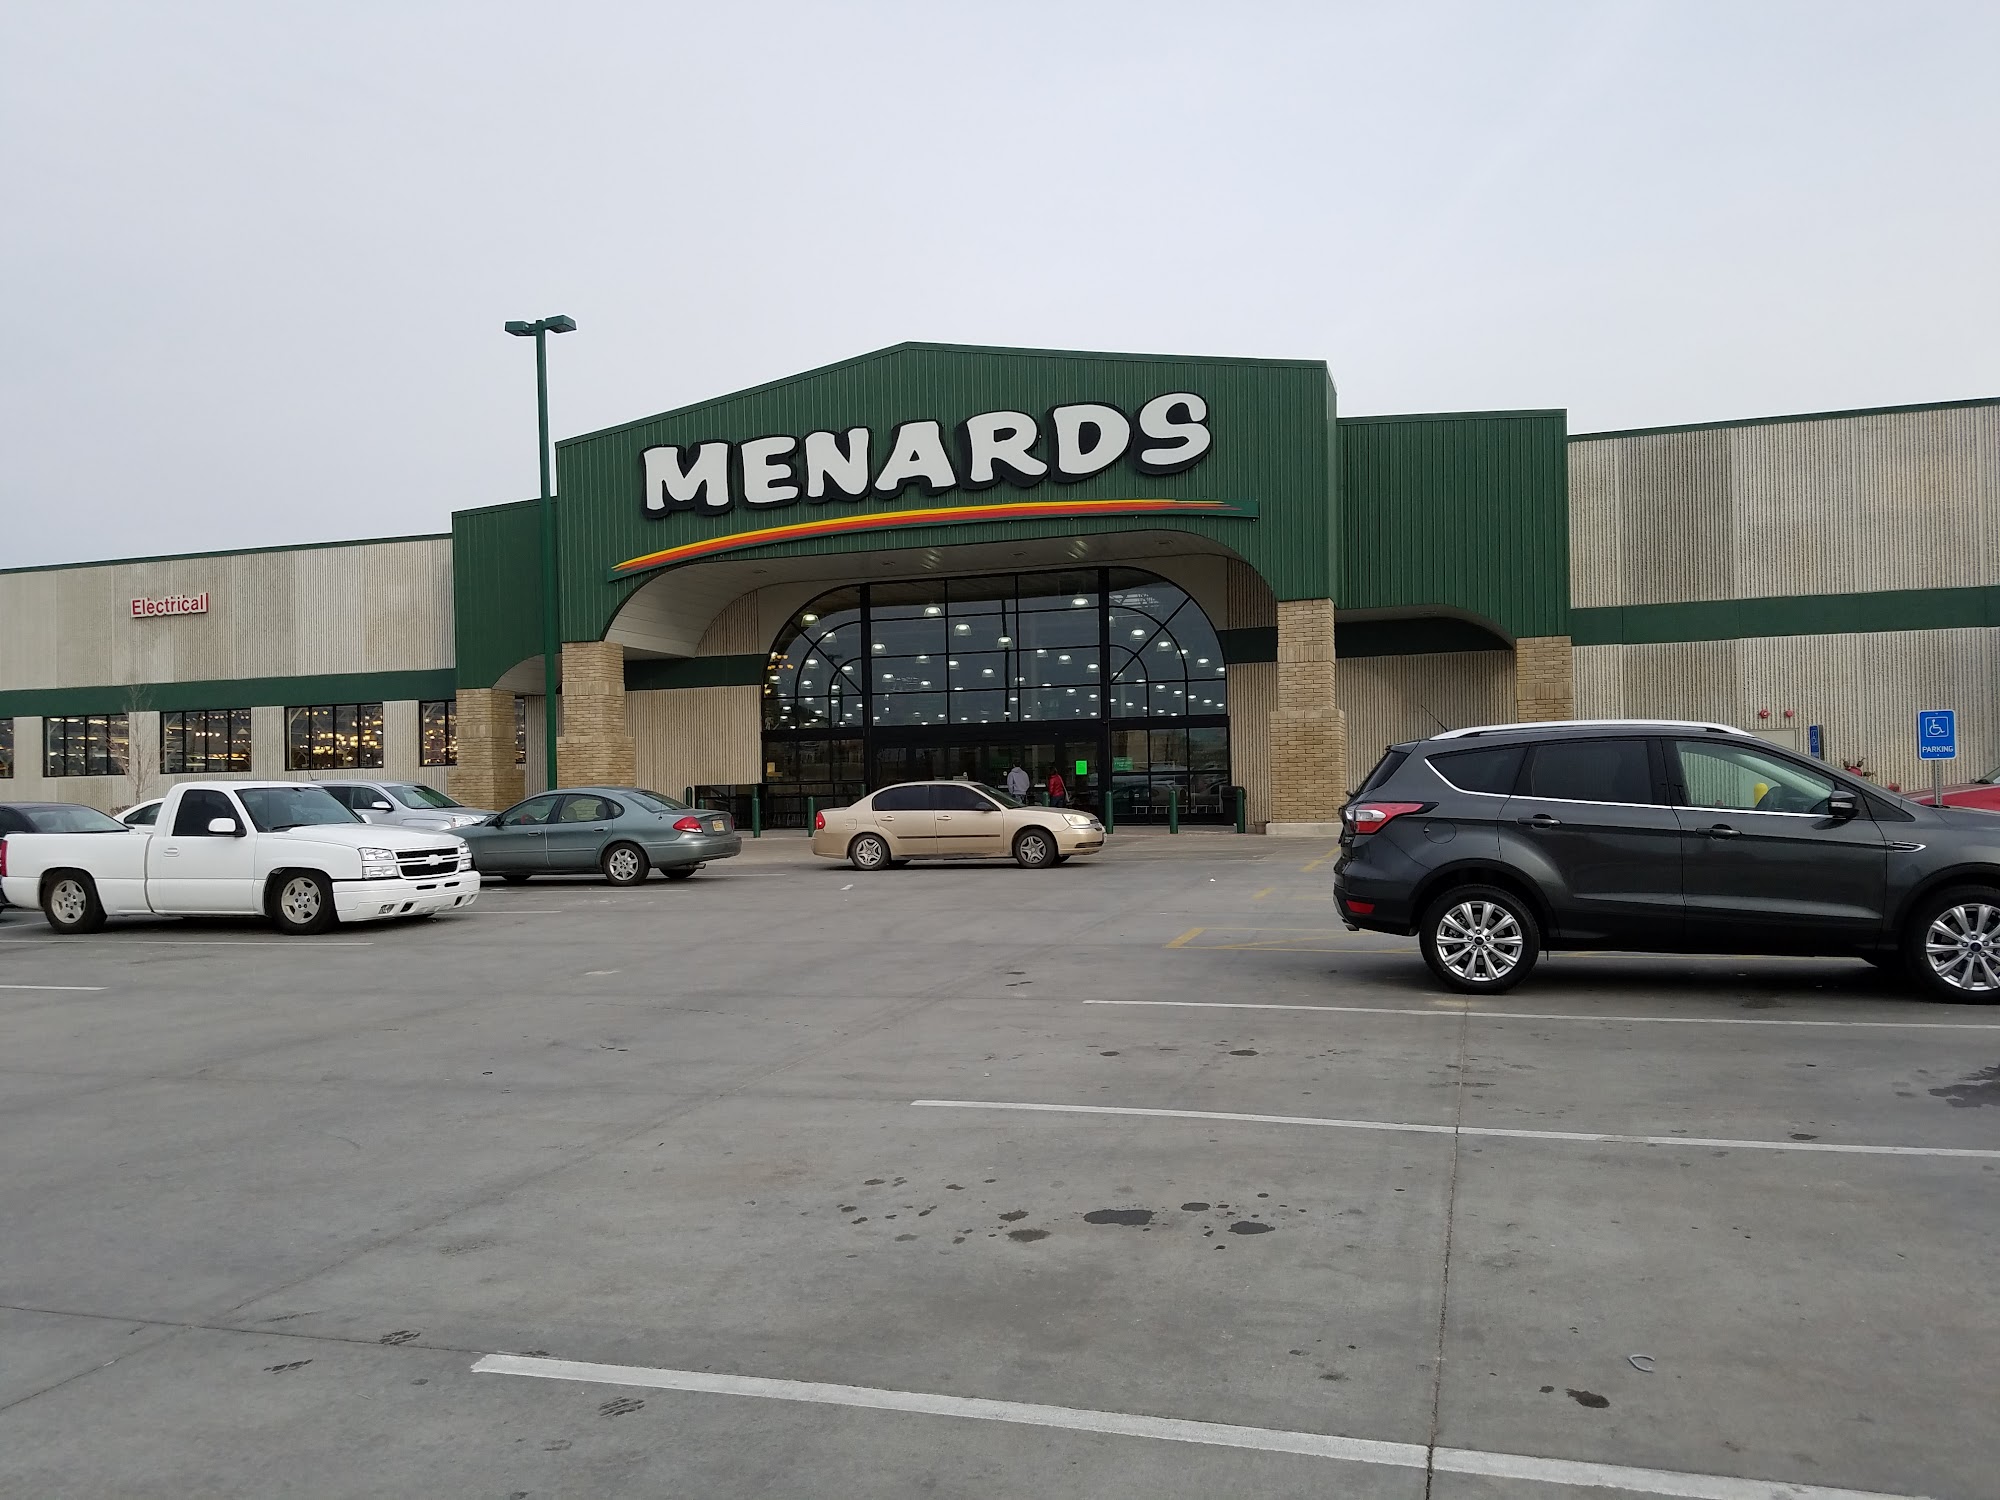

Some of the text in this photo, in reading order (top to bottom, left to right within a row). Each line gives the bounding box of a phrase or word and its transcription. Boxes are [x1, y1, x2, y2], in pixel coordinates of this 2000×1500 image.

[642, 393, 1211, 512] MENARDS
[132, 593, 208, 615] Electrical
[1922, 745, 1954, 753] PARKING
